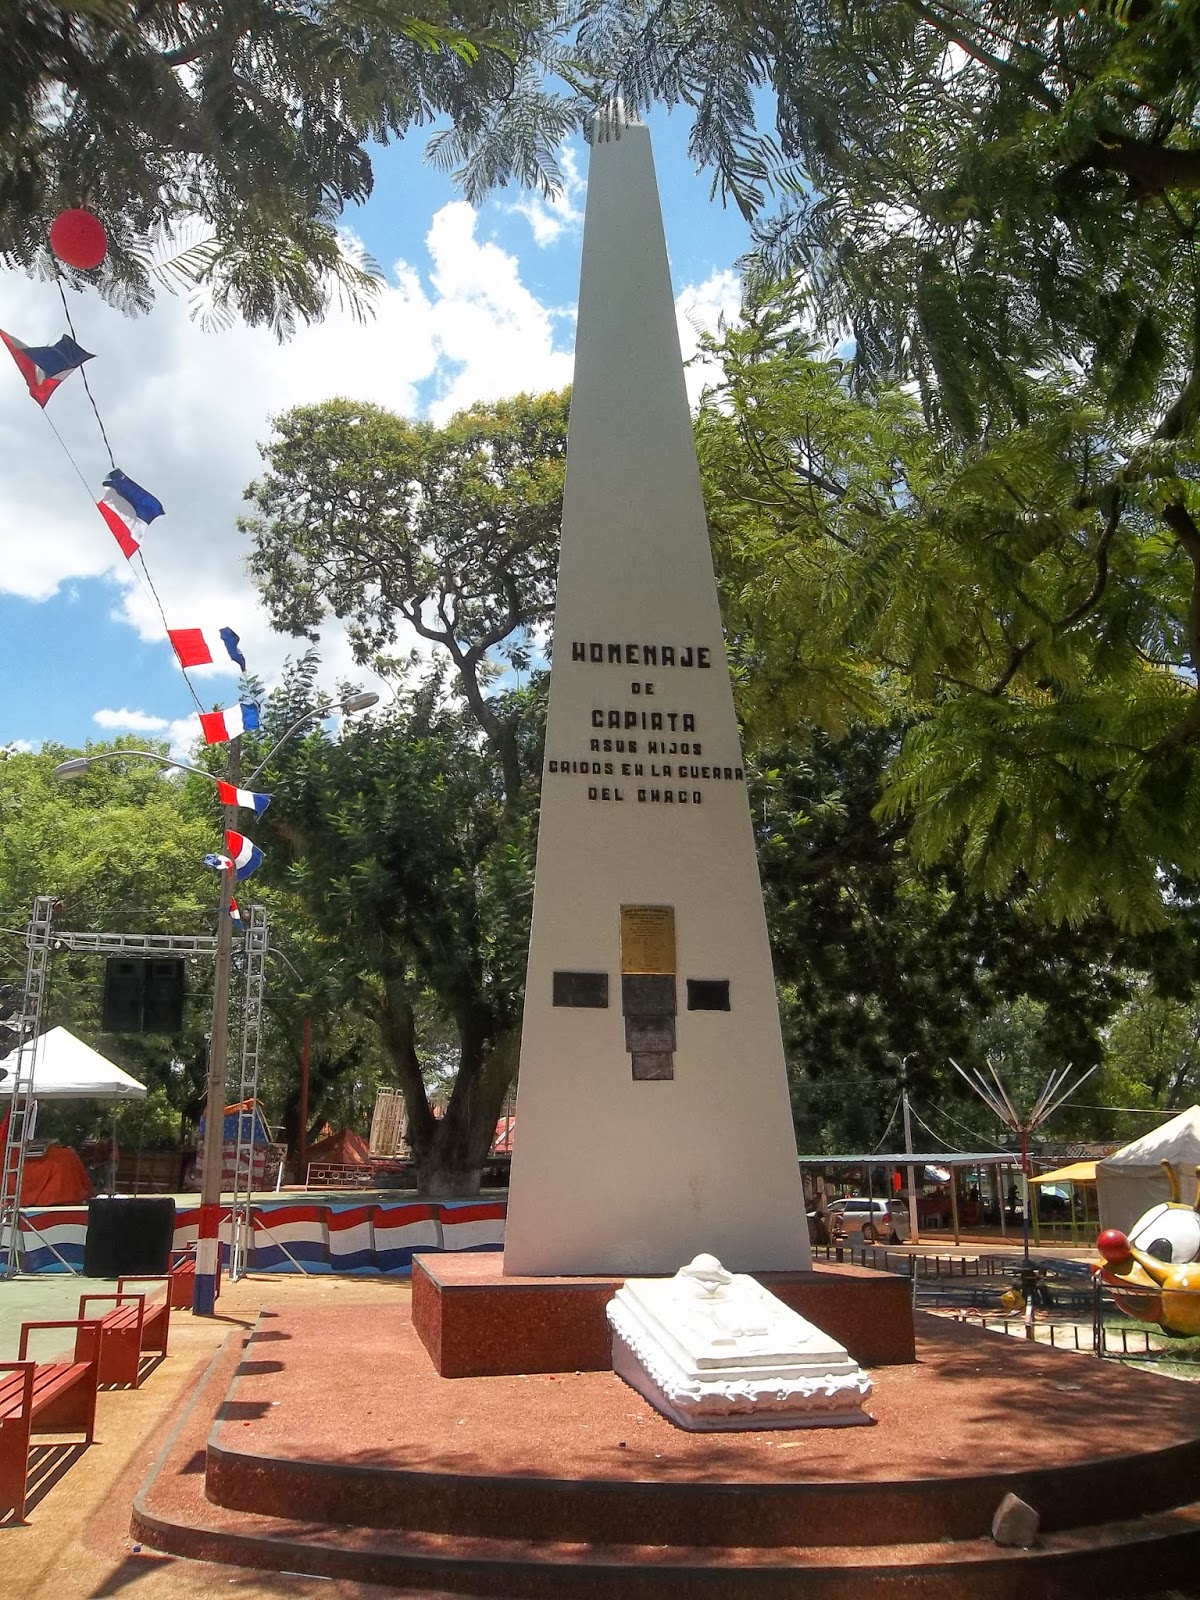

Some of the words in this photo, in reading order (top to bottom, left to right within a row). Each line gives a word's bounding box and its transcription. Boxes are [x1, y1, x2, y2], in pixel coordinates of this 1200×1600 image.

[571, 641, 711, 669] HOMENAJE
[631, 681, 655, 696] DE
[591, 709, 696, 733] CAPIATA
[647, 741, 702, 756] HIJOS
[548, 760, 614, 775] CAIDOS
[621, 763, 644, 777] EN
[651, 765, 673, 778] LA
[678, 765, 744, 781] GUERRA
[587, 787, 624, 802] DEL
[637, 789, 702, 805] CHACO
